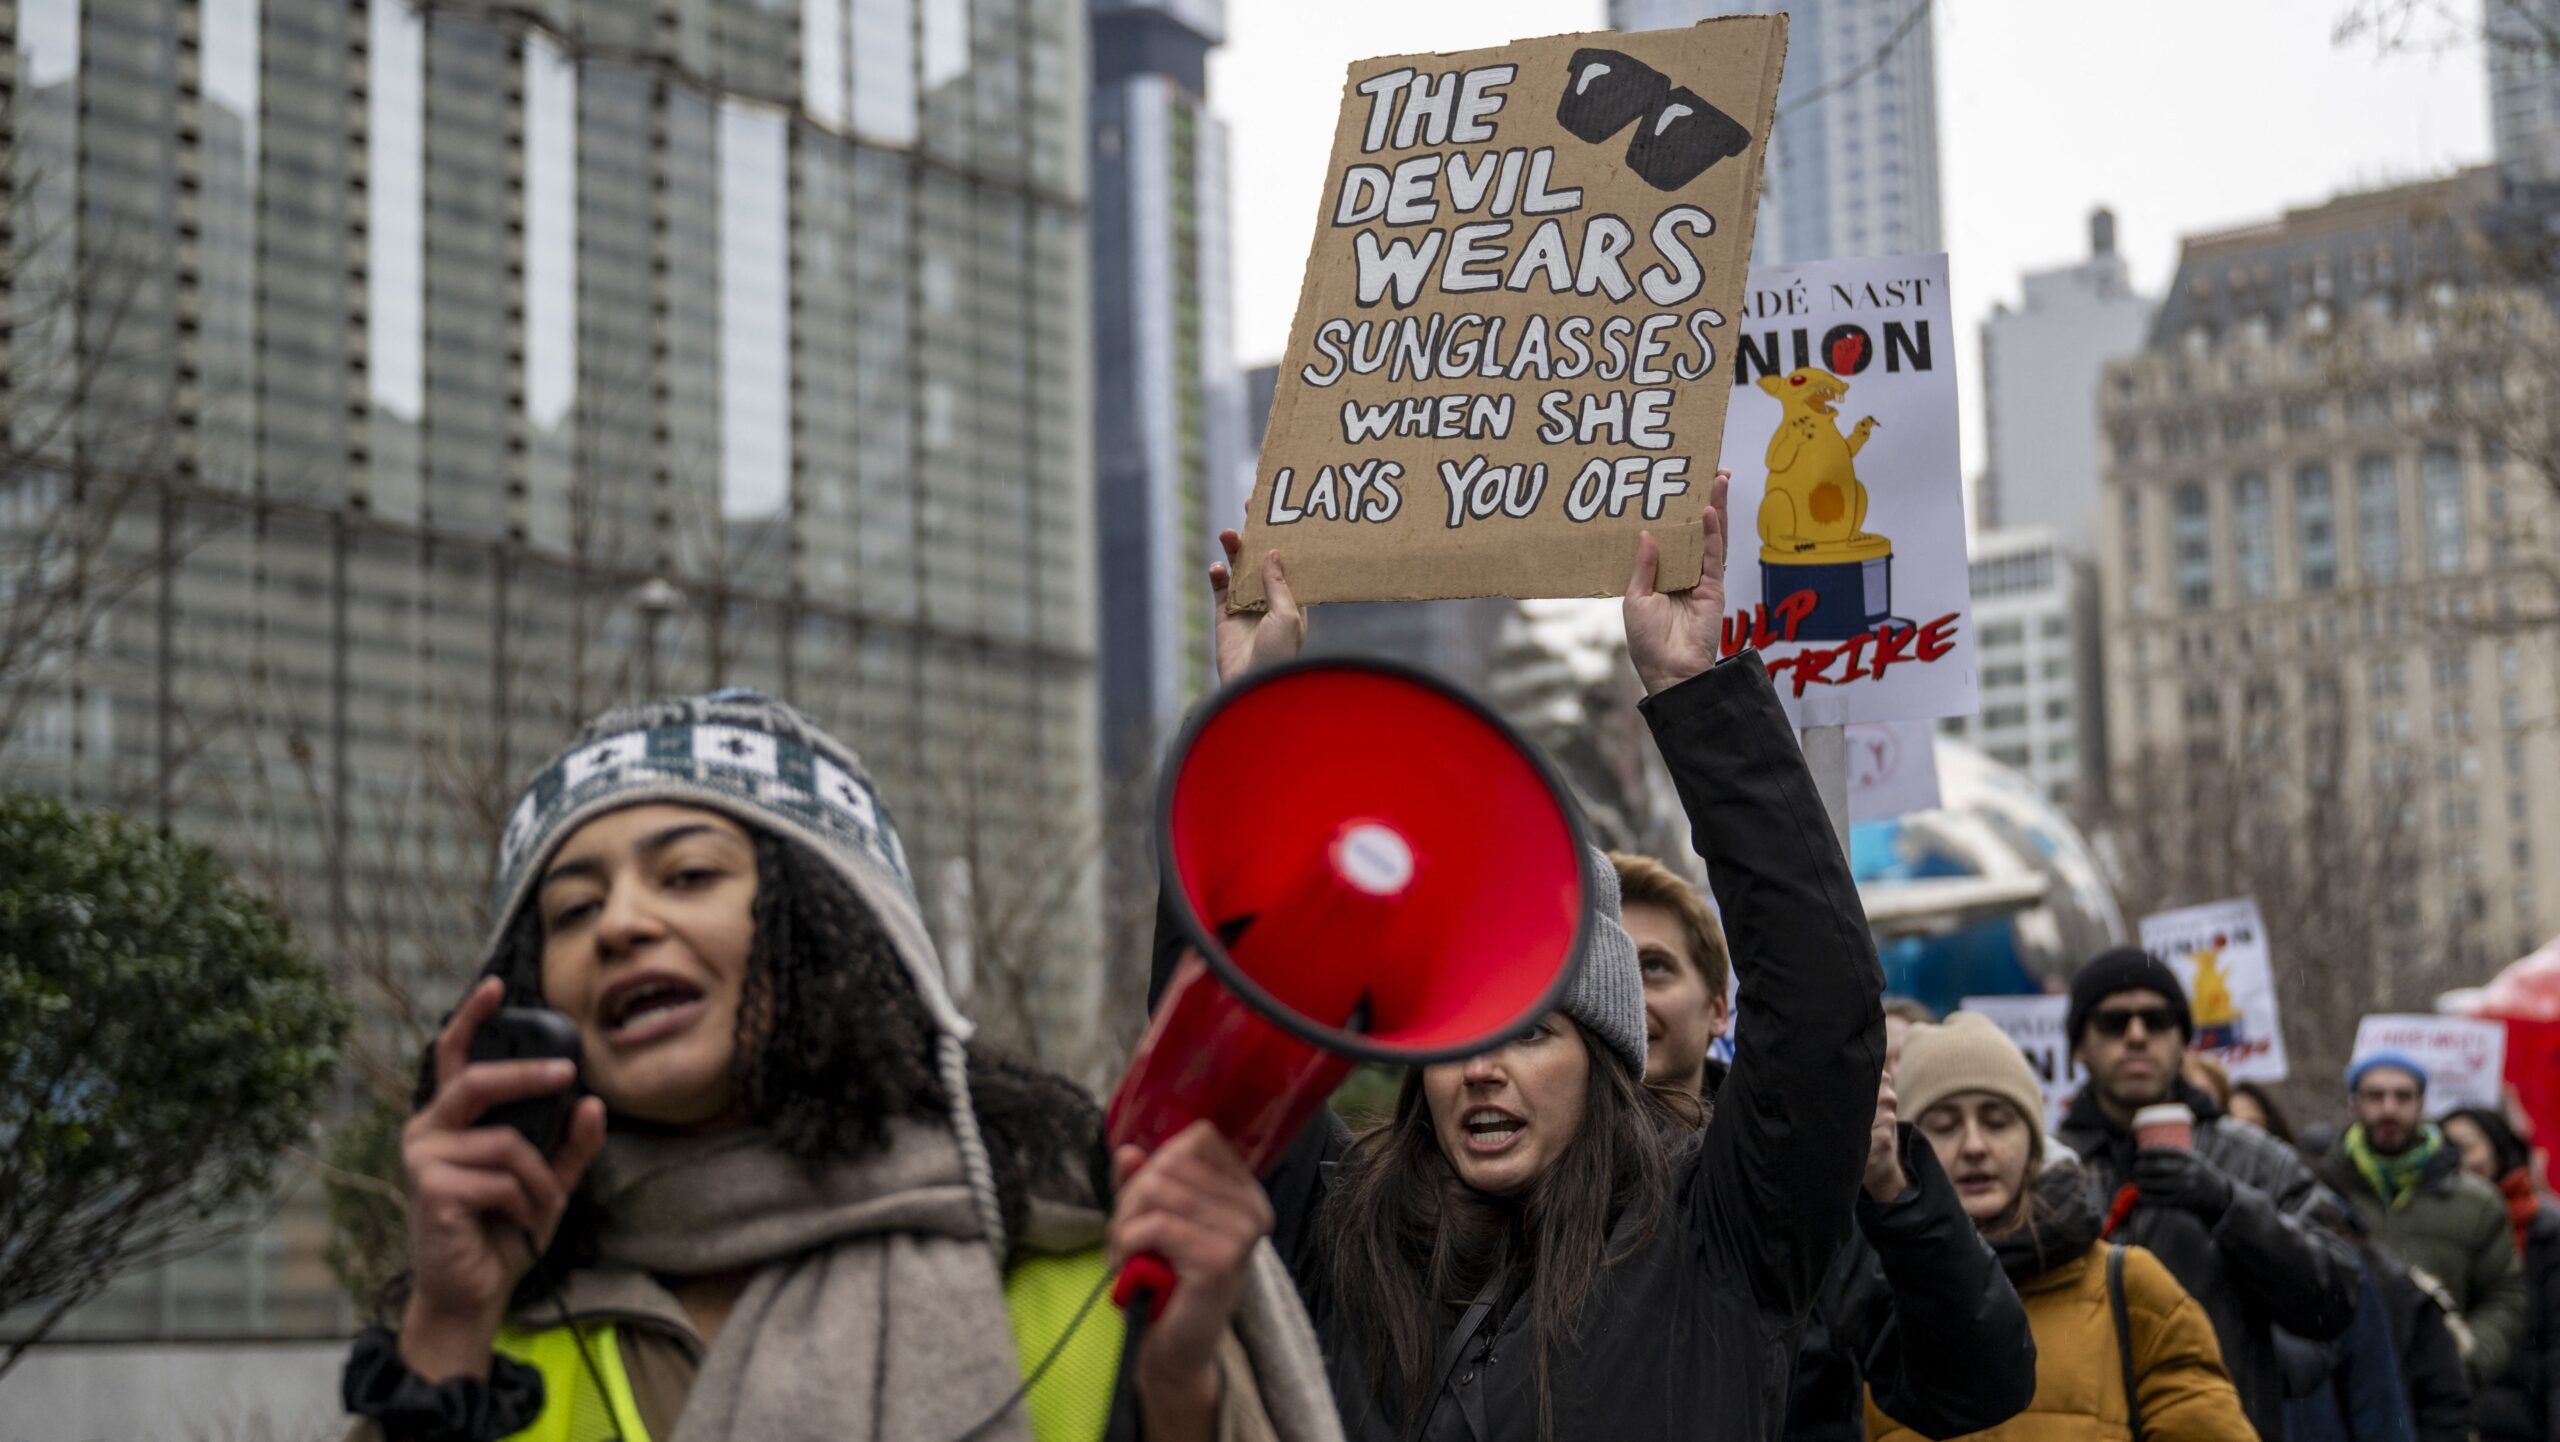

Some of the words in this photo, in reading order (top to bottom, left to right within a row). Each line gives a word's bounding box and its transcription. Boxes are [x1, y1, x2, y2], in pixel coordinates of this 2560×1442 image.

[1356, 64, 1518, 153] THE
[1332, 146, 1583, 228] DEVIL
[1353, 203, 1716, 308] WEARS
[1829, 278, 1930, 312] NAST
[1301, 308, 1727, 388] SUNGLASSES
[1735, 320, 1932, 385] NION
[1342, 394, 1515, 444] WHEN
[1537, 389, 1675, 450] SHE
[1266, 459, 1405, 526] LAYS
[1437, 455, 1548, 528] YOU
[1564, 456, 1692, 521] OFF
[1720, 589, 1818, 657] ULP
[1764, 612, 1960, 699] TRIKE
